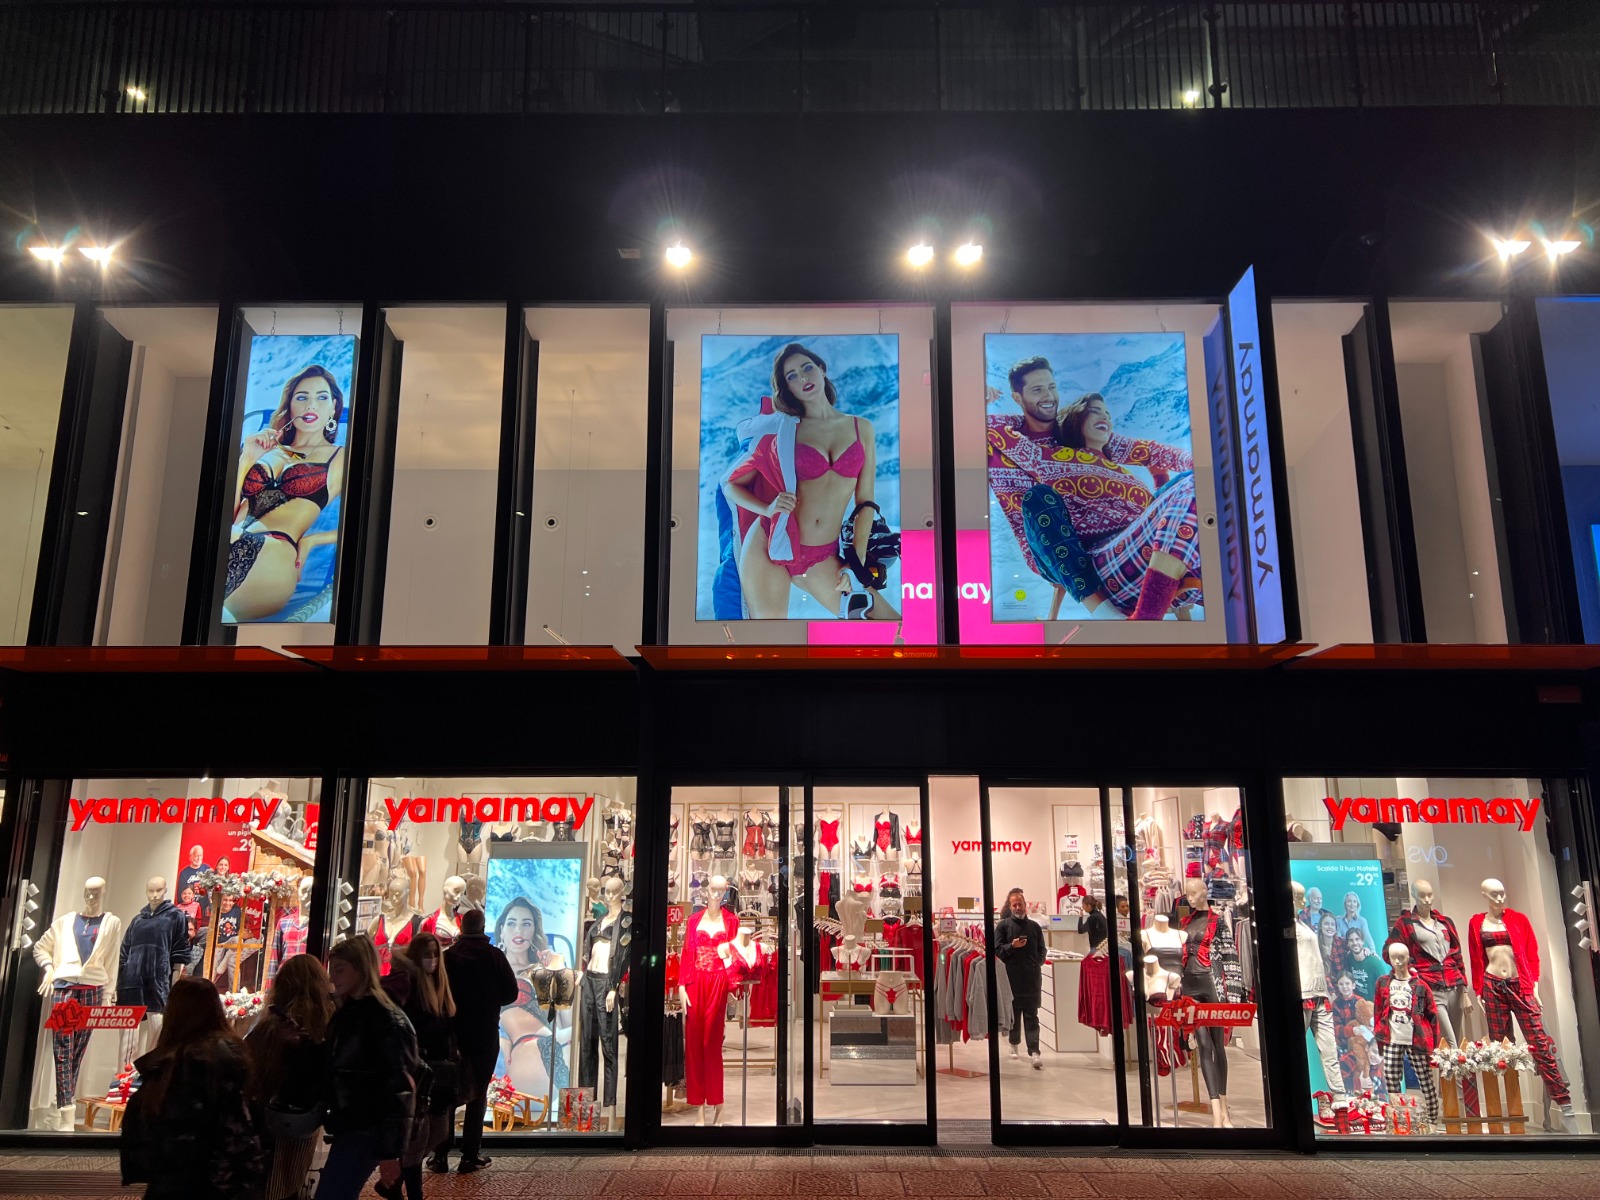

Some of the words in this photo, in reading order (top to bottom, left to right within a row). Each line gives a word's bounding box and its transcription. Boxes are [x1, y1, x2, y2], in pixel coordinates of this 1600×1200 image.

[1238, 341, 1274, 588] yamamay
[992, 479, 1013, 487] JUST
[69, 797, 284, 832] yamamay
[384, 797, 594, 831] yamamay
[1323, 797, 1540, 832] yamamay
[86, 1018, 97, 1027] IN
[98, 1018, 136, 1027] REGALO
[90, 1008, 104, 1017] UN
[105, 1008, 133, 1017] PLAID
[1197, 1010, 1209, 1019] IN
[1210, 1010, 1251, 1020] REGALO
